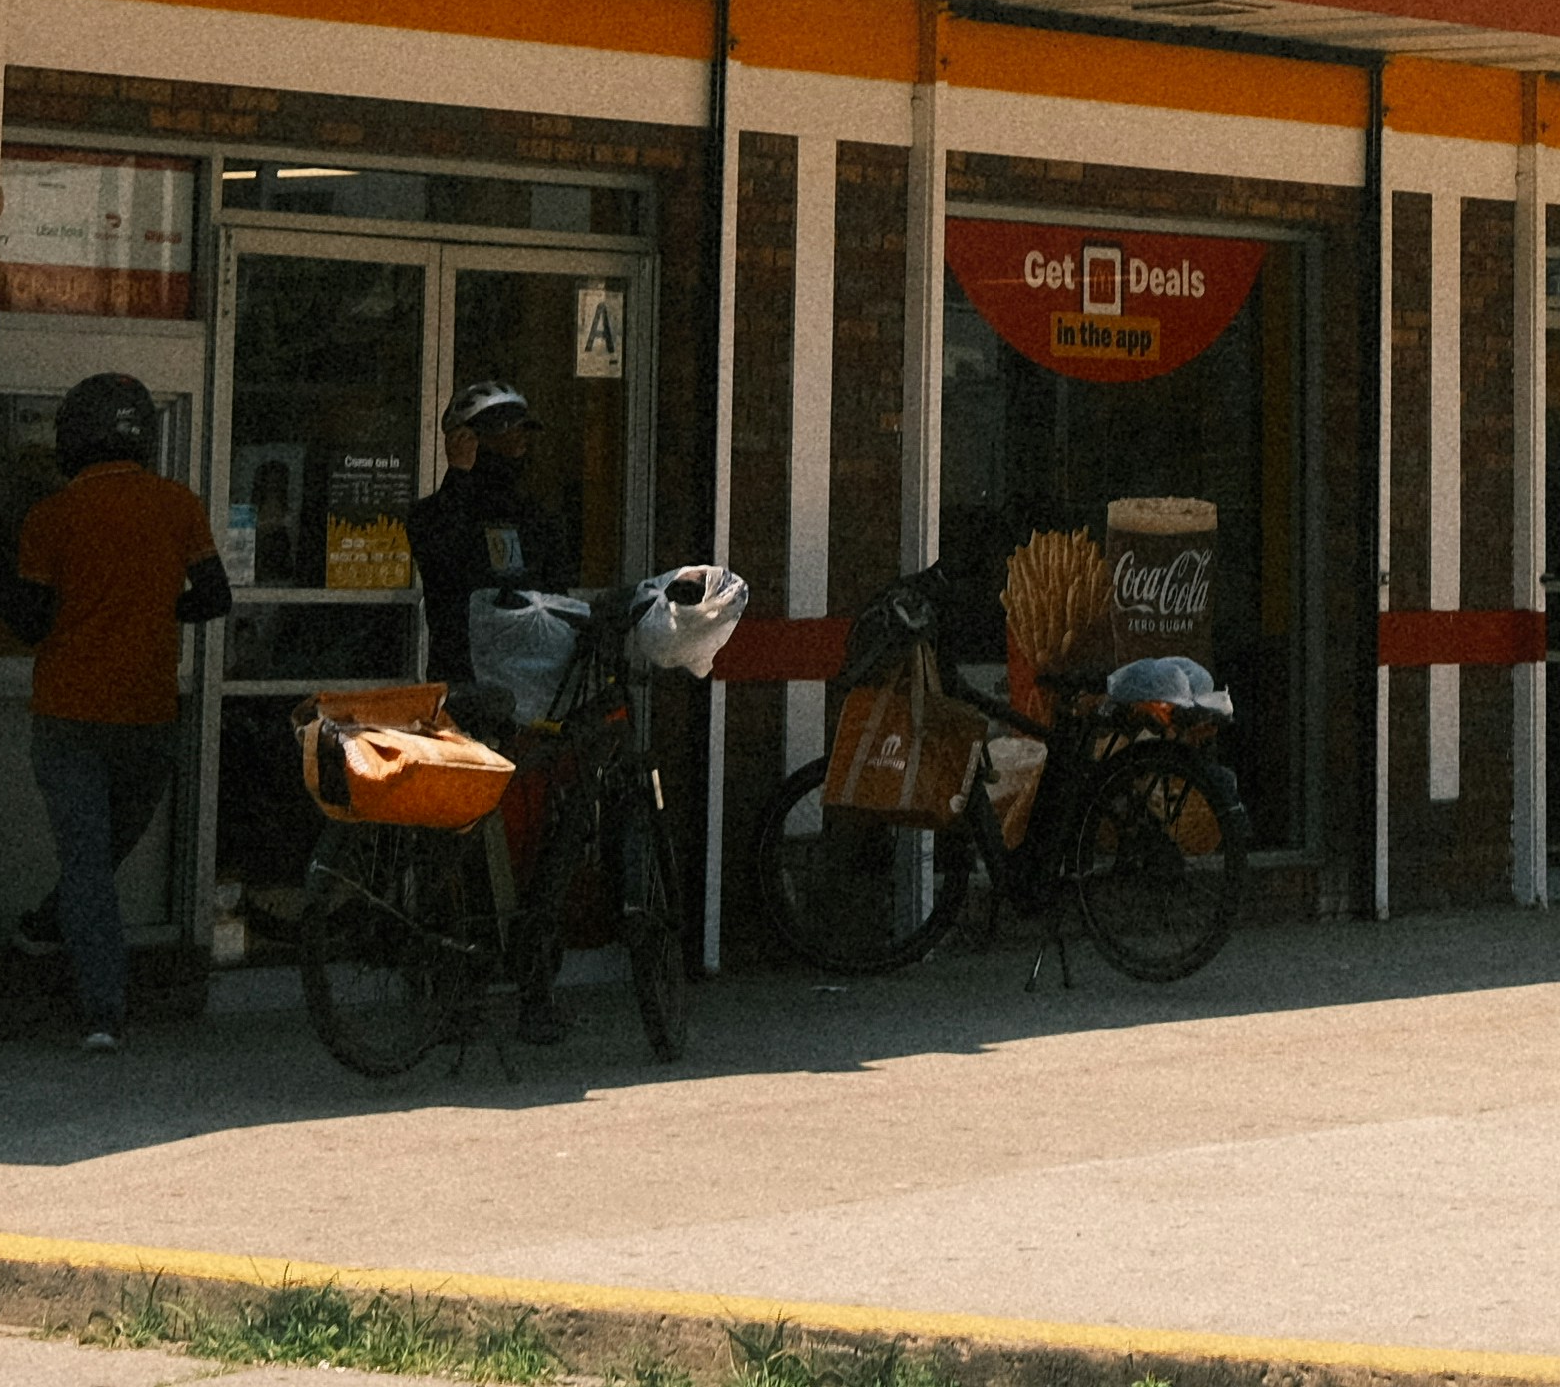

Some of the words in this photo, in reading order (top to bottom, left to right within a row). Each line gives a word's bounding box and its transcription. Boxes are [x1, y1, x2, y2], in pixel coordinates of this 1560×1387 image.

[1023, 249, 1076, 291] Get
[1129, 257, 1206, 299] Deals
[584, 301, 615, 354] A
[1056, 316, 1076, 346] in
[1080, 320, 1113, 348] the
[1115, 327, 1153, 358] app
[1127, 617, 1156, 633] ZERO
[1159, 617, 1194, 633] SUGAR
